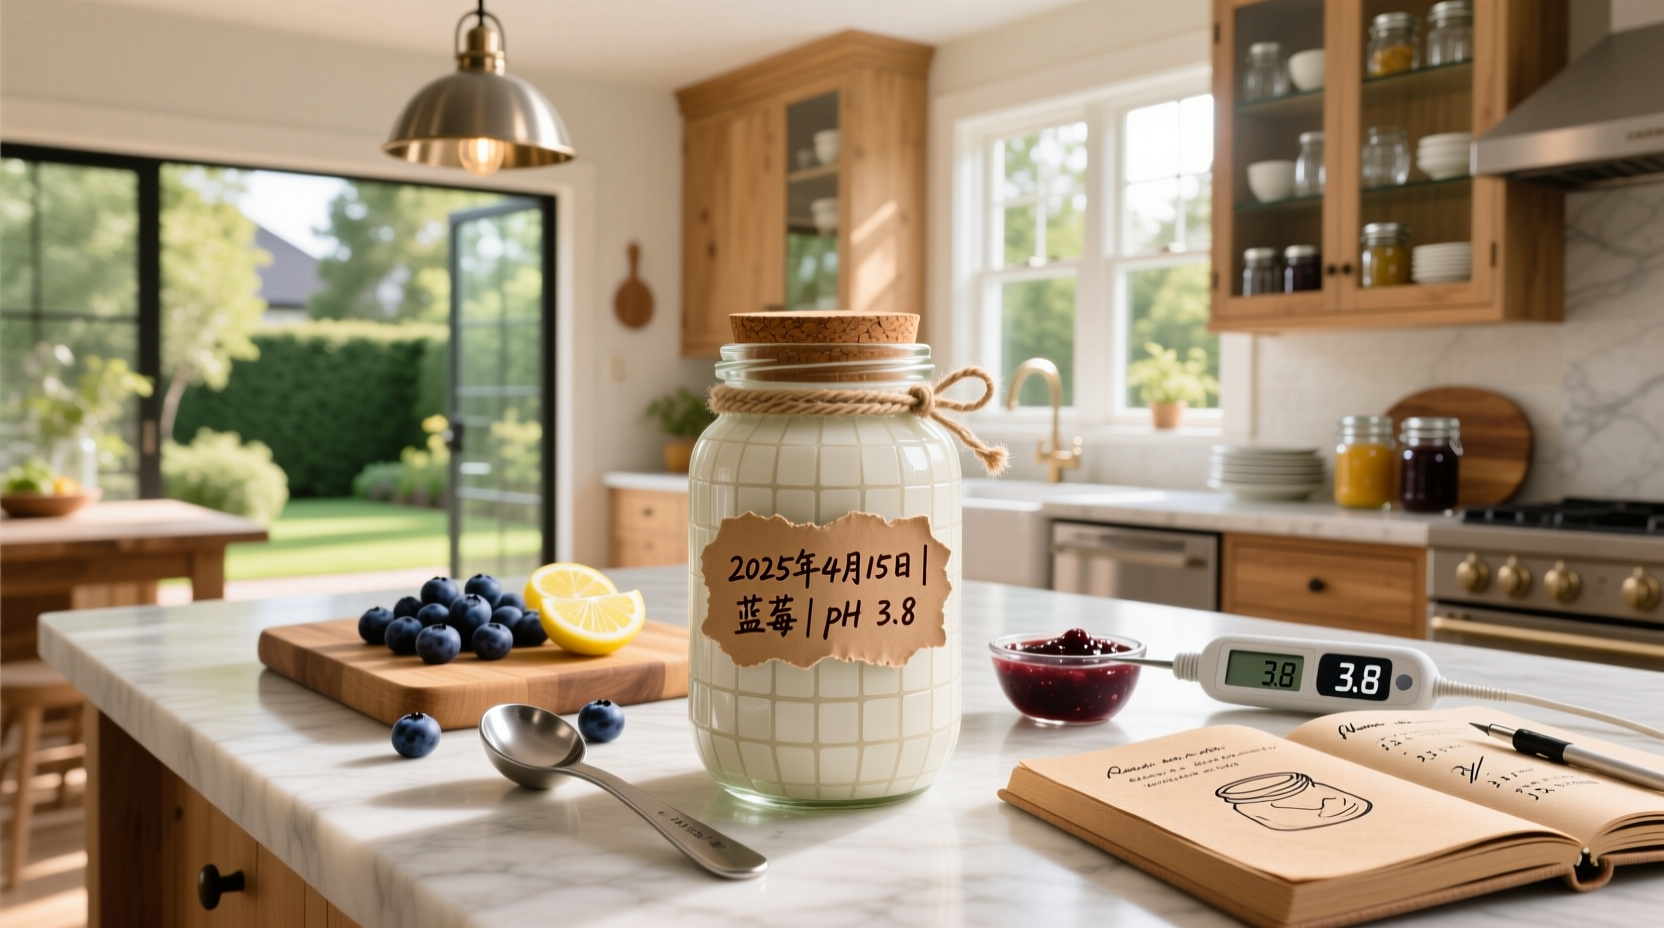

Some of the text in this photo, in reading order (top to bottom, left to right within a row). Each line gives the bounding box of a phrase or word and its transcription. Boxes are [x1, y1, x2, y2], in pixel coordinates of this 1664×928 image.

[728, 548, 911, 589] 2025年4月15日
[734, 594, 797, 638] 蓝莓
[823, 599, 862, 640] pH
[876, 597, 917, 626] 3.8
[1261, 660, 1297, 689] 3.8
[1334, 662, 1382, 695] 3.8
